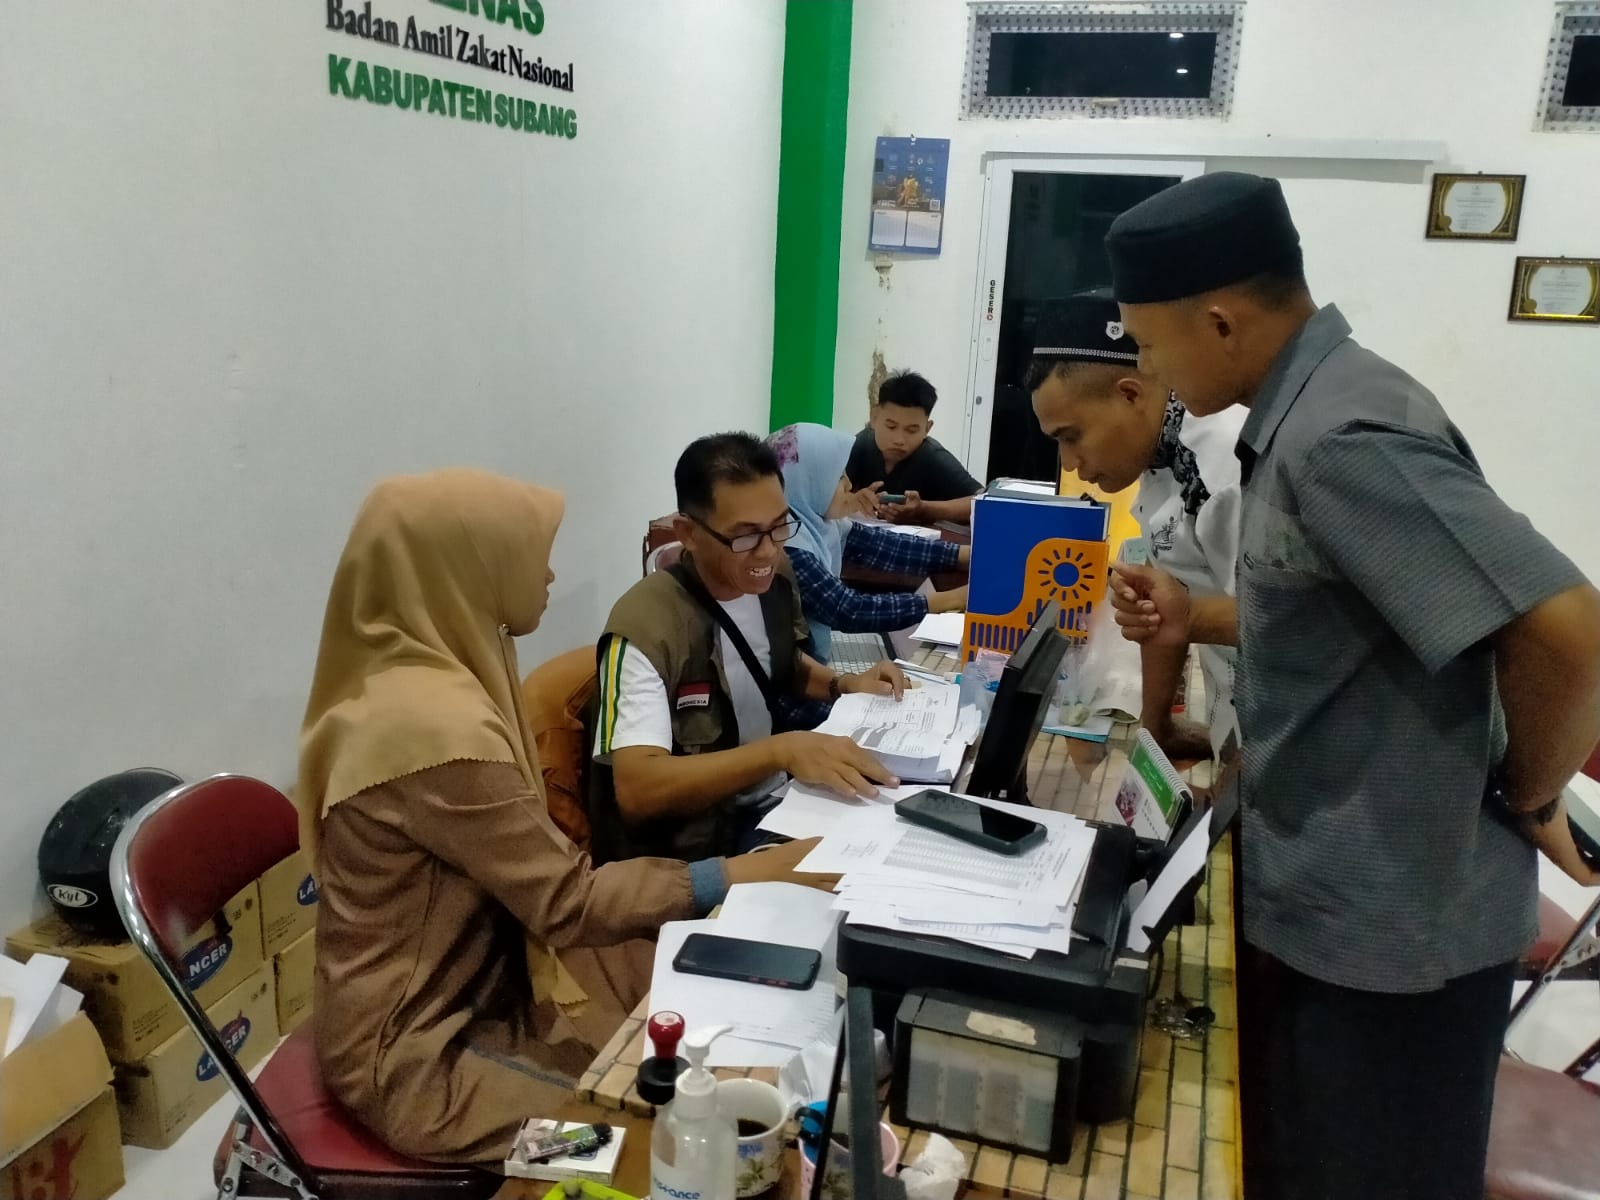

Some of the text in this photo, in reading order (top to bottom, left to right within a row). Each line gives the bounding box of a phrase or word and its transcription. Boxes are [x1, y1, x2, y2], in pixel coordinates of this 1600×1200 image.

[326, 0, 574, 92] Badan Amil Zakat Nasional
[327, 53, 577, 139] KABUPATEN SUBANG
[189, 943, 228, 977] NCER
[198, 1025, 246, 1077] LACER
